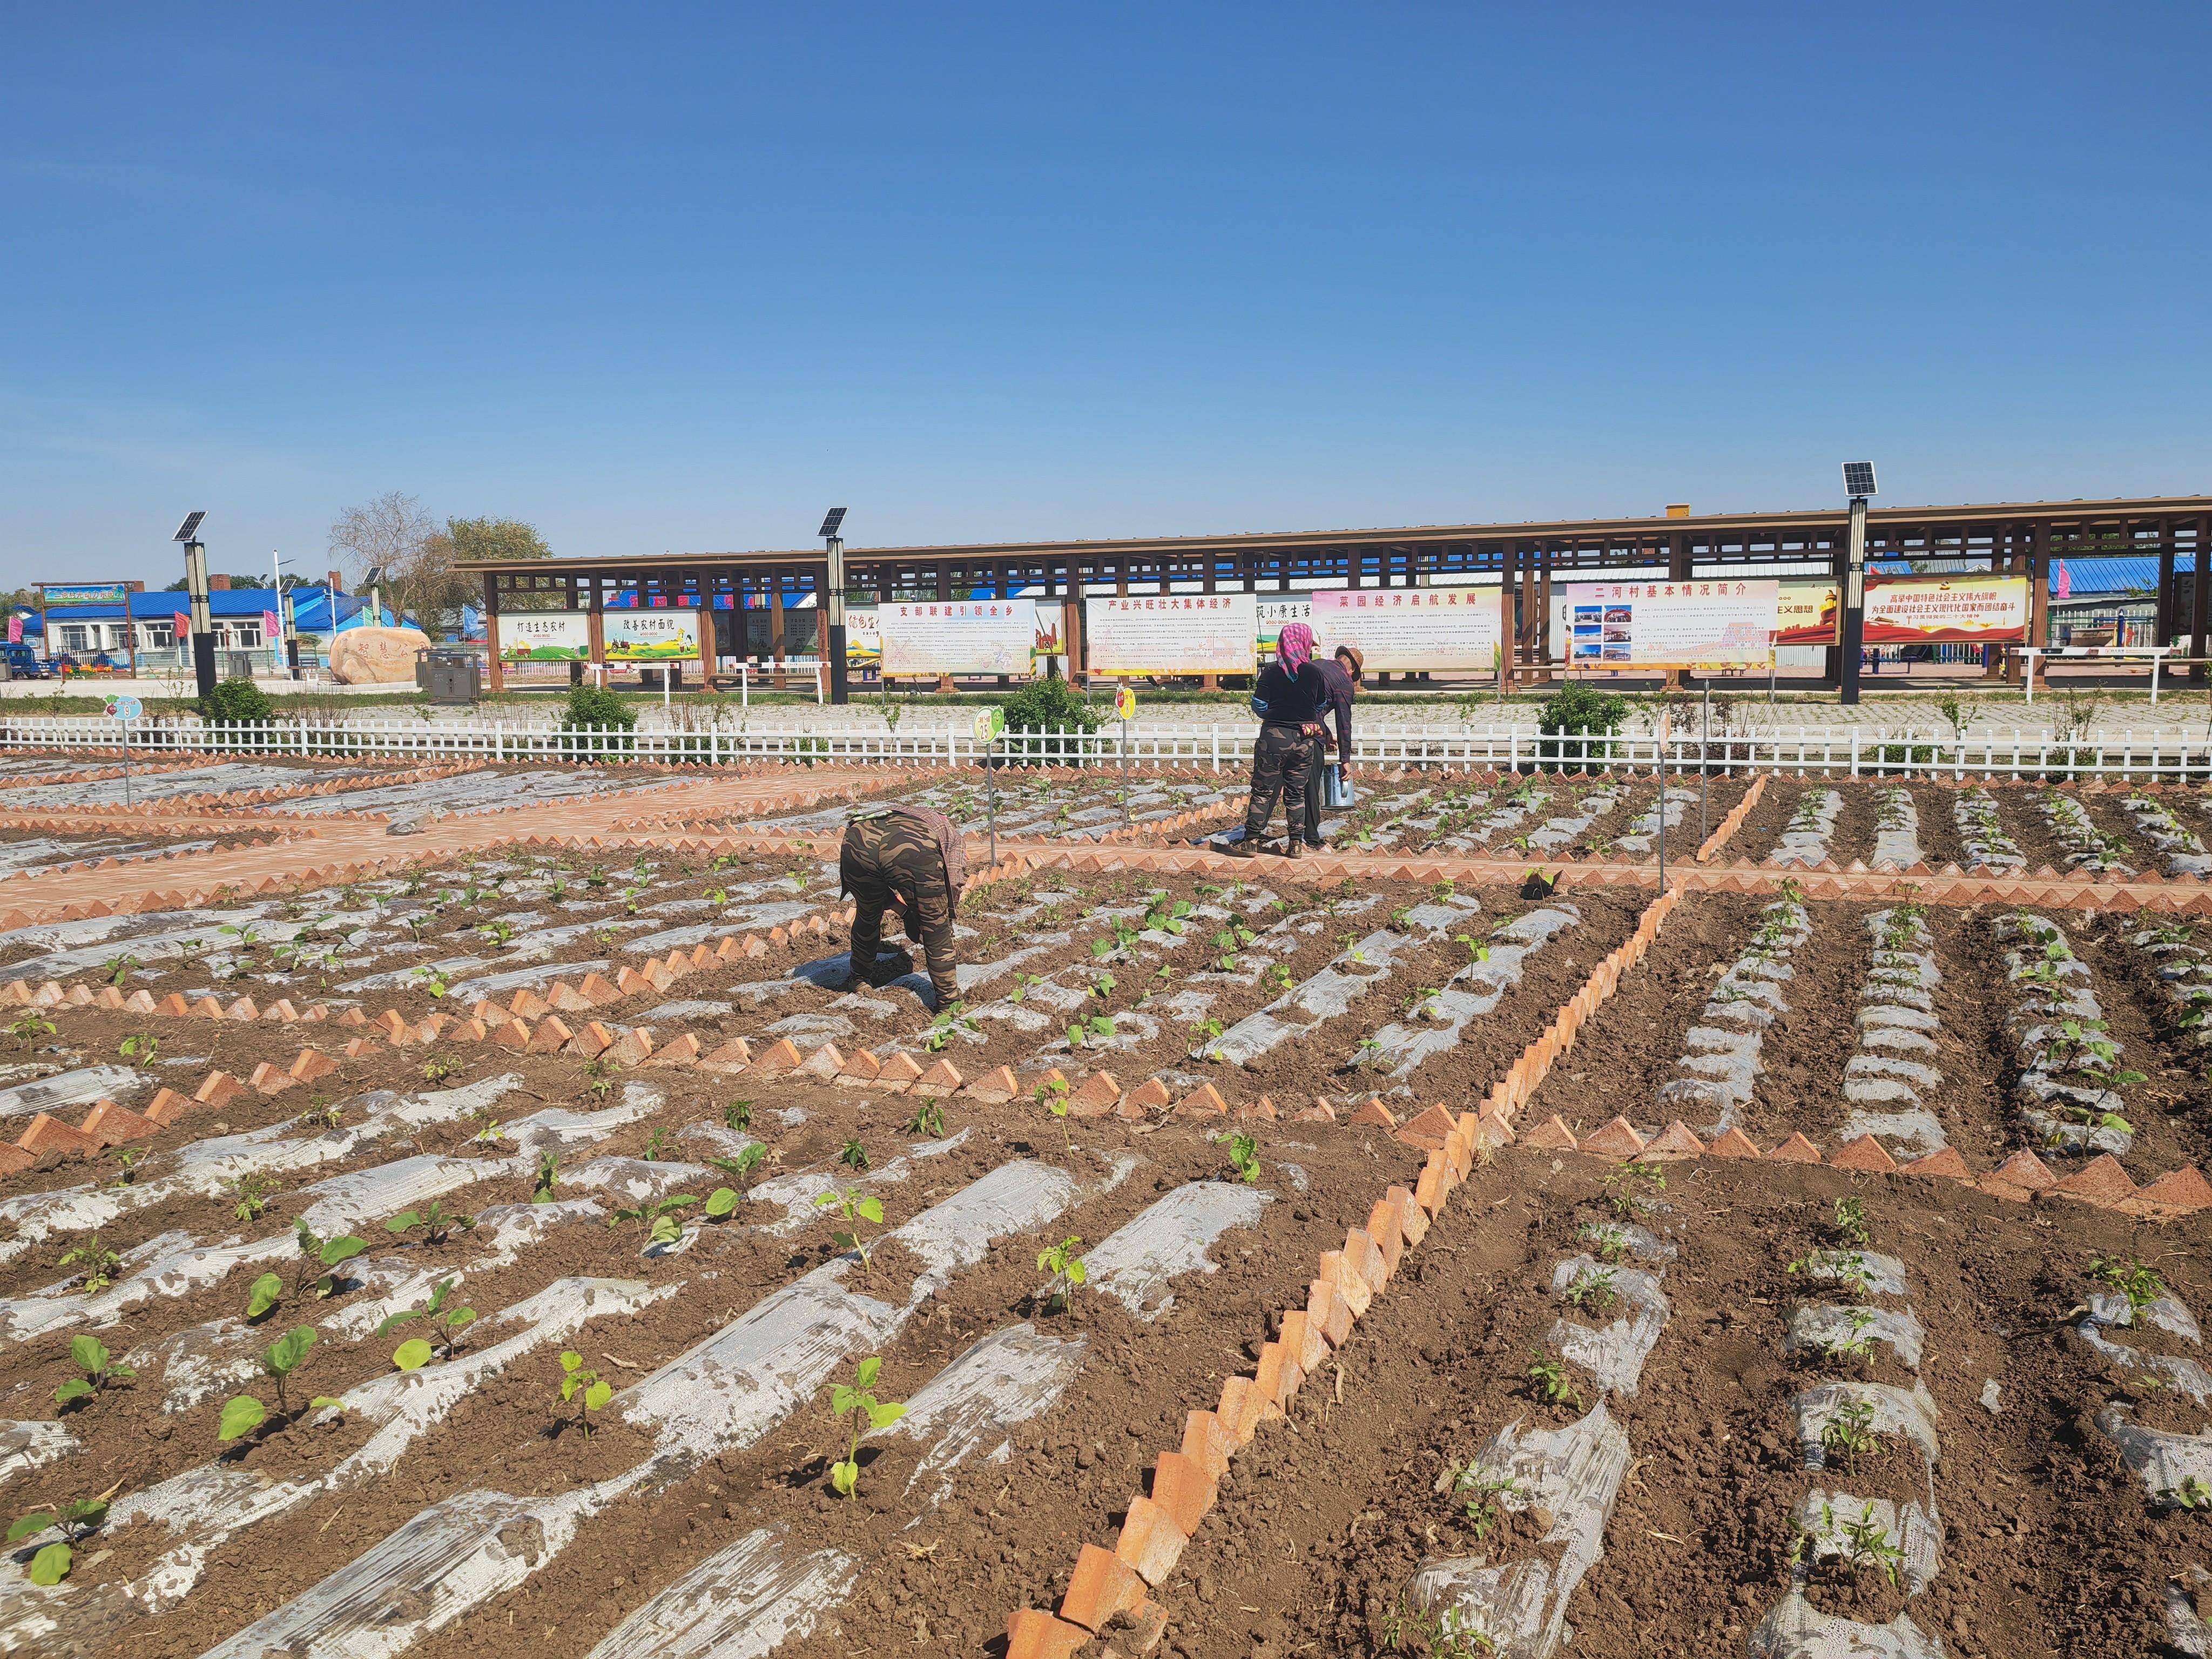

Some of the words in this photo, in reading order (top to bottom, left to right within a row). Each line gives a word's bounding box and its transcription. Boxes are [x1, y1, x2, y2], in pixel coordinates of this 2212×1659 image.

[1595, 583, 1746, 598] 二河村基本情况简介
[1108, 597, 1232, 611] 产业兴旺壮大集体经济
[1339, 592, 1476, 608] 菜园经济启航发展
[1890, 592, 1997, 603] 高举中国特色社会主义伟大旗帜
[900, 605, 1013, 617] 支部联建引领全乡
[1872, 602, 2015, 614] 为全面建设社会主义现代化国家而团结奋斗
[517, 620, 565, 633] 打造生态农村
[623, 618, 676, 631] 改善农村面貌
[848, 613, 880, 629] 绿色生
[980, 724, 988, 740] 25
